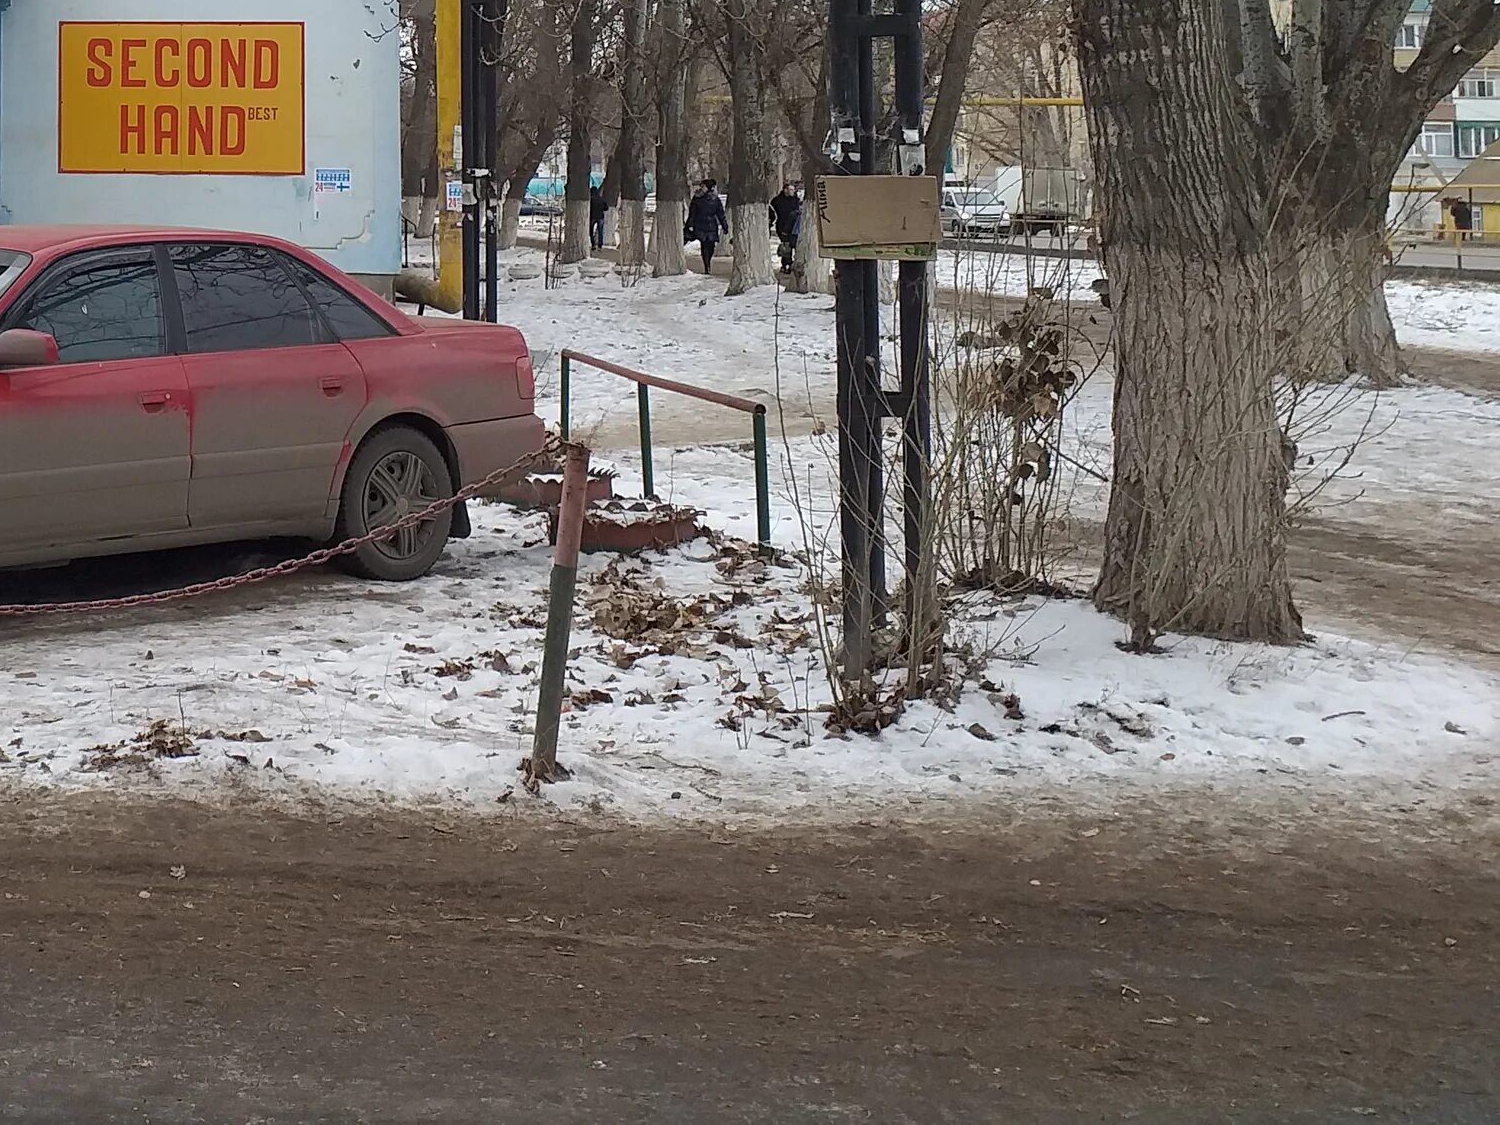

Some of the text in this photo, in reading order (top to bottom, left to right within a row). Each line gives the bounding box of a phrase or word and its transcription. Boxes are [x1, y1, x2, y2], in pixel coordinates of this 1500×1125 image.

[86, 38, 279, 89] SECOND
[120, 105, 278, 155] HAND BEST
[315, 182, 323, 192] 24
